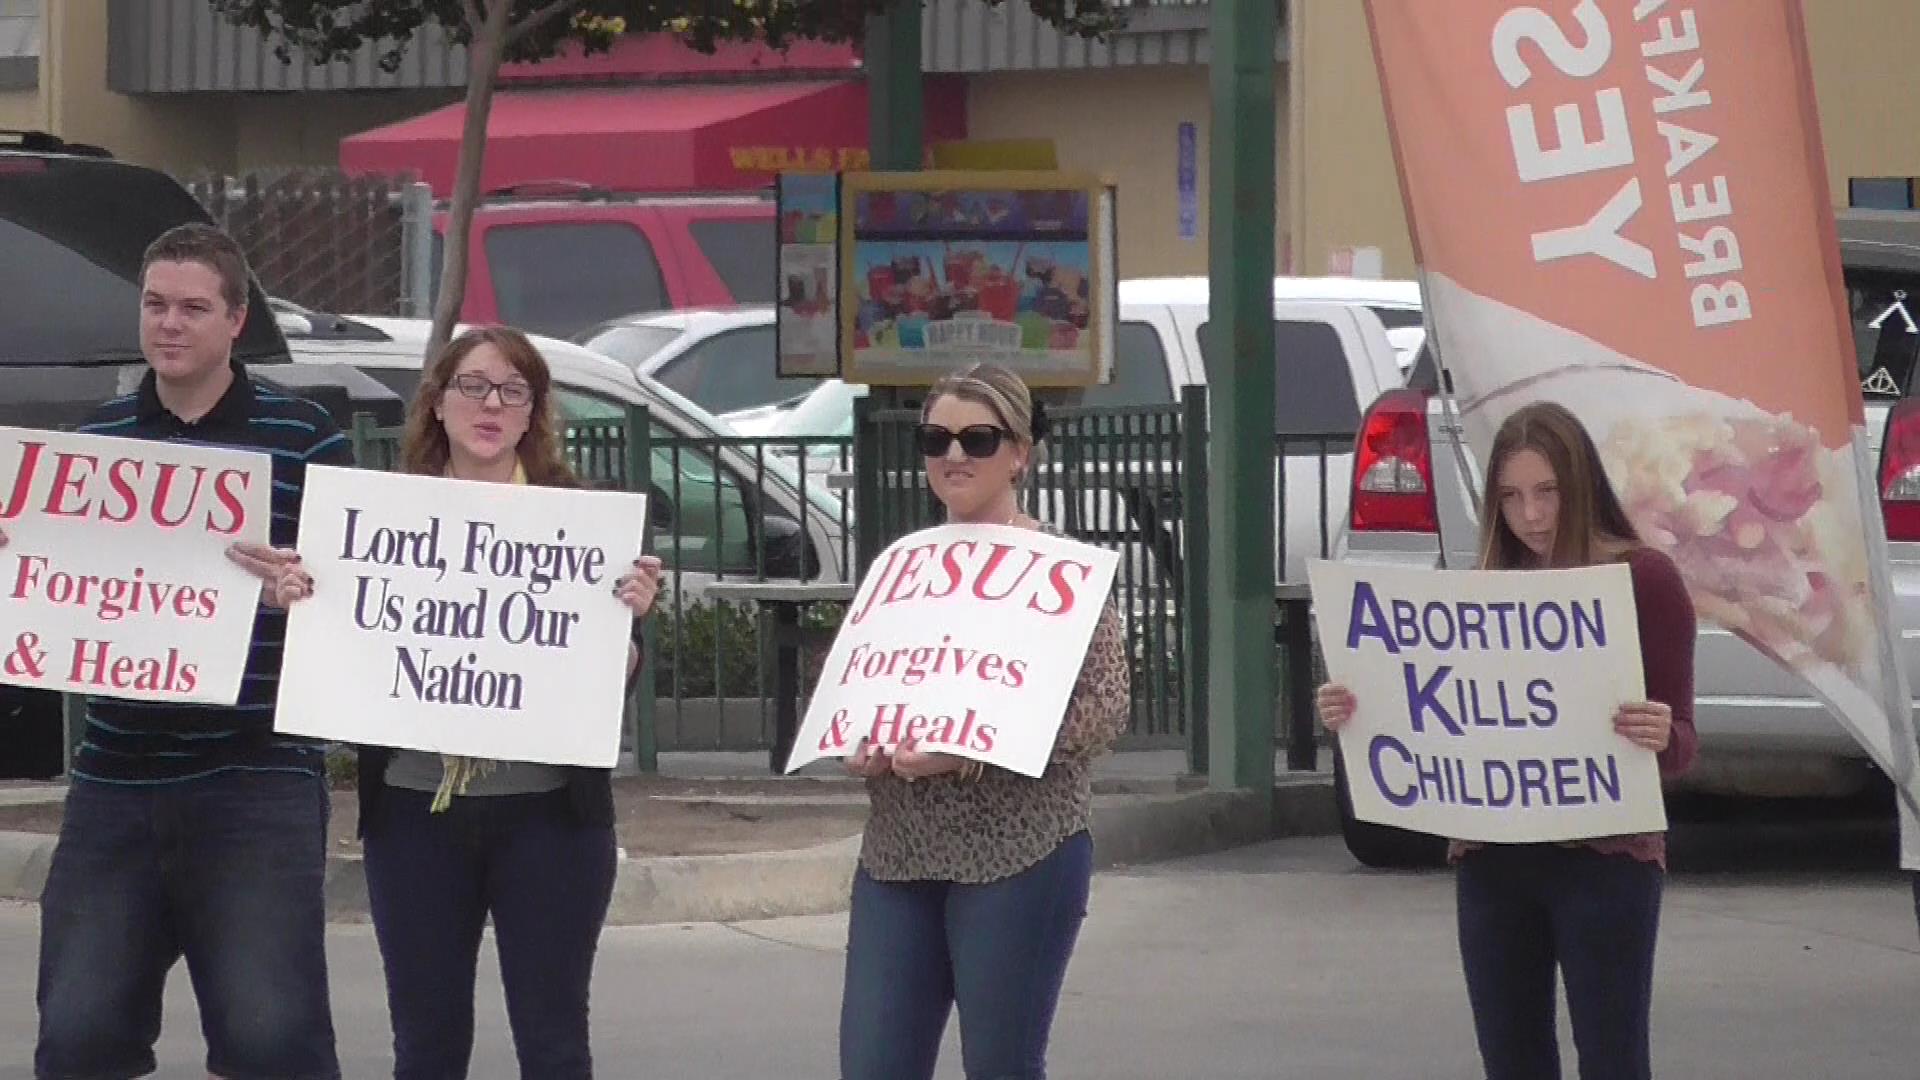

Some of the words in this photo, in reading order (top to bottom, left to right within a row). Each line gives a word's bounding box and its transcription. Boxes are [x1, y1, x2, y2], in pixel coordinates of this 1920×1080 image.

[0, 441, 251, 536] JESUS
[339, 507, 447, 583] Lord,
[461, 521, 606, 594] Forgive
[851, 540, 1093, 625] JESUS
[11, 555, 219, 620] Forgives
[354, 576, 403, 633] Us
[412, 596, 486, 640] and
[499, 591, 579, 649] Our
[1346, 581, 1607, 655] ABORTION
[4, 631, 45, 680] &
[66, 638, 199, 694] Heals
[390, 646, 524, 711] Nation
[840, 634, 1029, 689] Forgives
[818, 708, 852, 751] &
[867, 703, 998, 752] Heals
[1403, 661, 1559, 736] KILLS
[1368, 734, 1622, 808] CHILDREN
